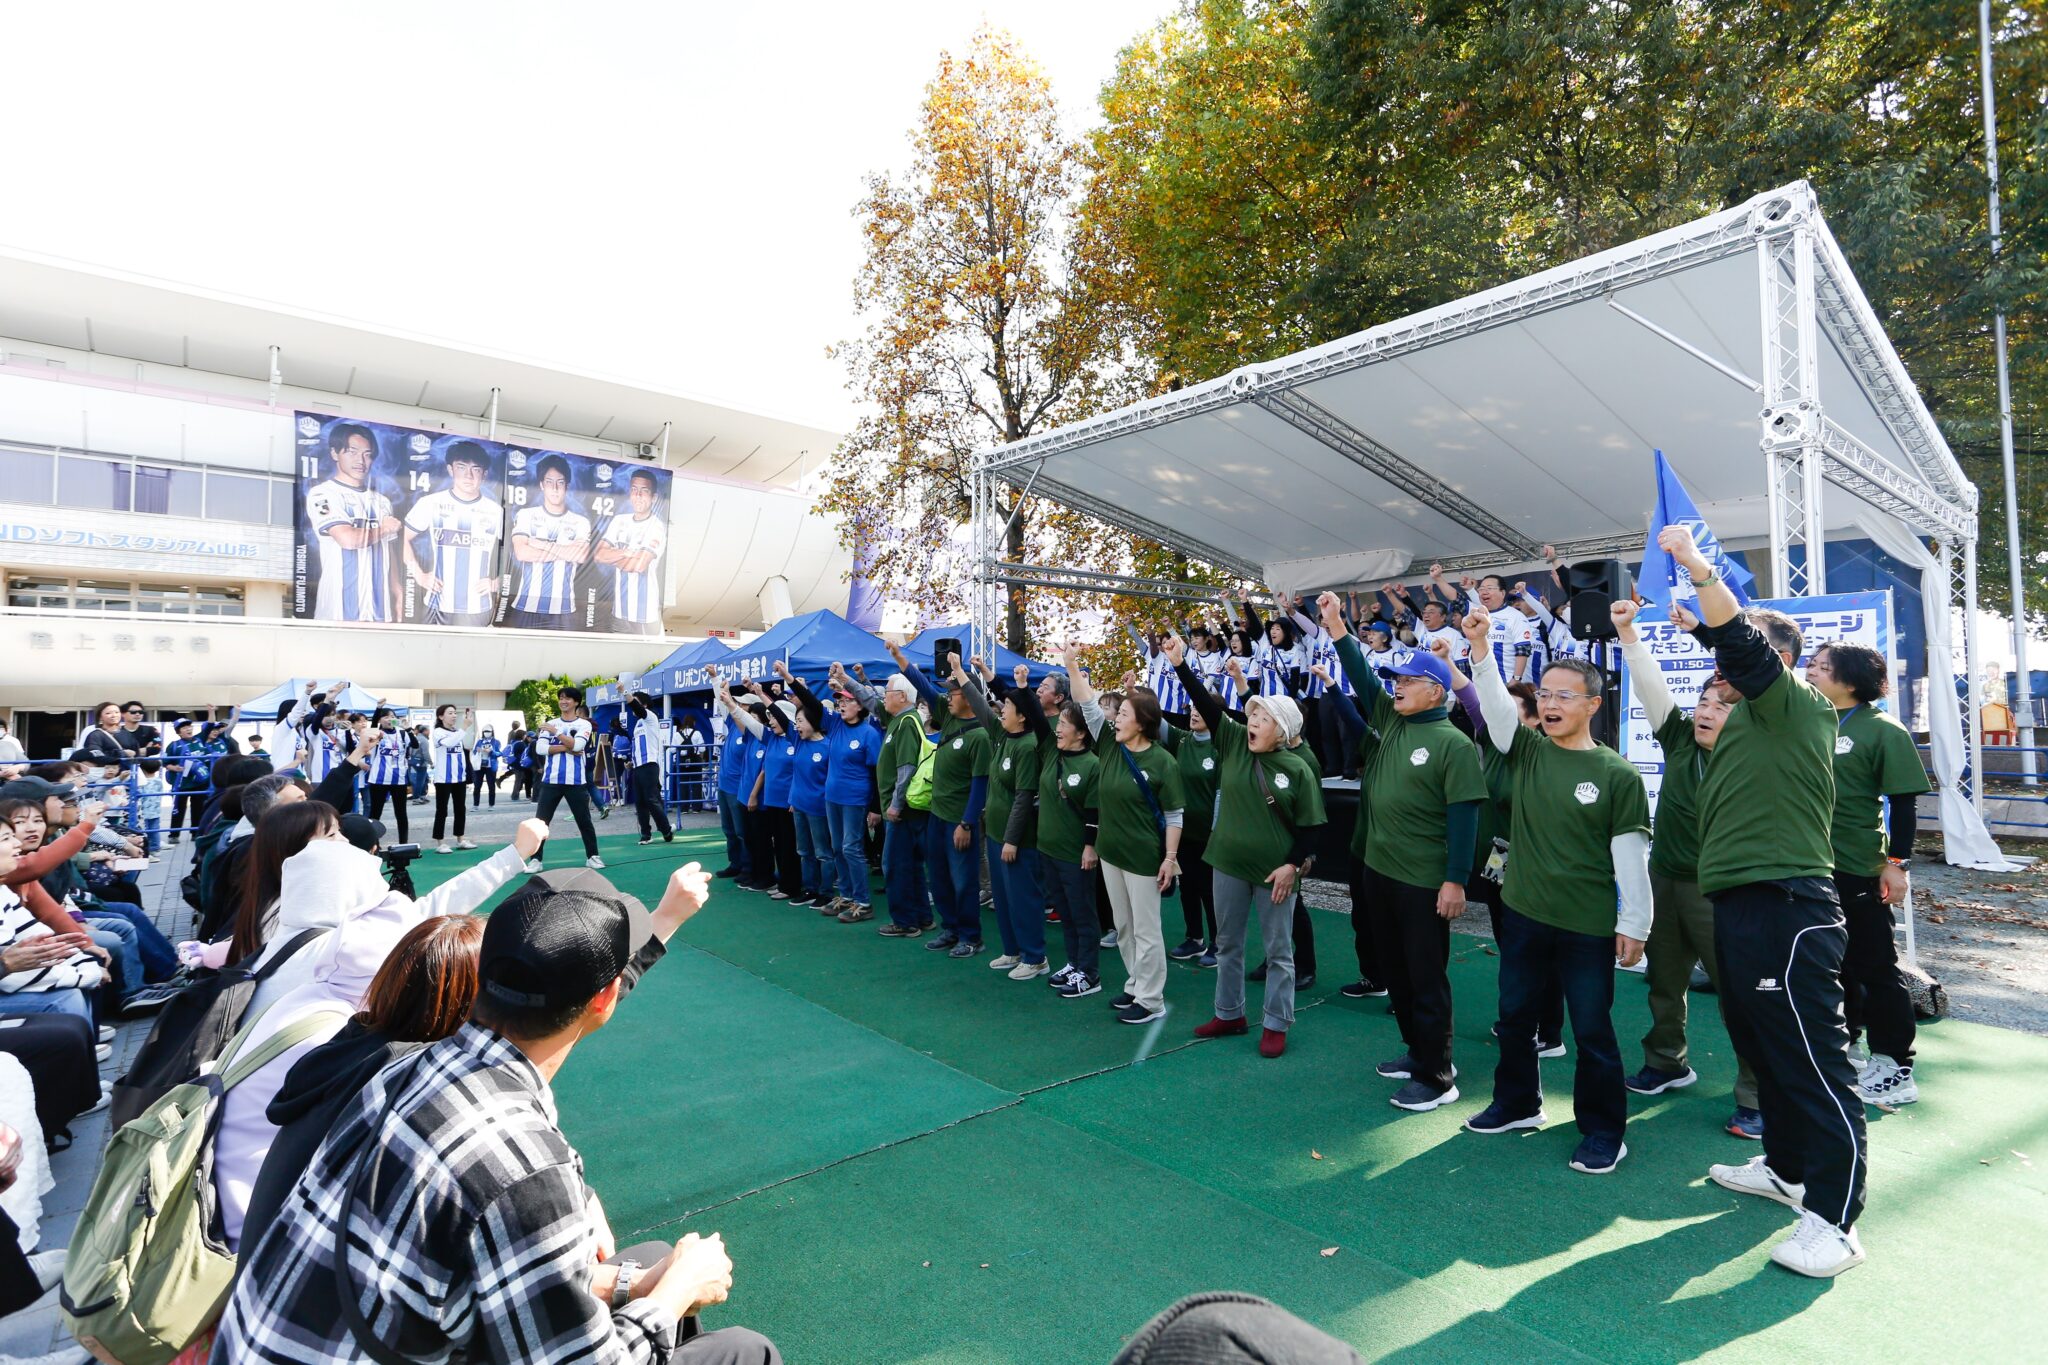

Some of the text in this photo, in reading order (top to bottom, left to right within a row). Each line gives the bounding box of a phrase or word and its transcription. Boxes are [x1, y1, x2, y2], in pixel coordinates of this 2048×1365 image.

[301, 456, 318, 478] 11
[410, 470, 430, 492] 14
[508, 485, 527, 505] 18
[592, 497, 615, 516] 42
[295, 576, 306, 612] FUJIMOTO
[679, 657, 760, 688] リボンマネット募金
